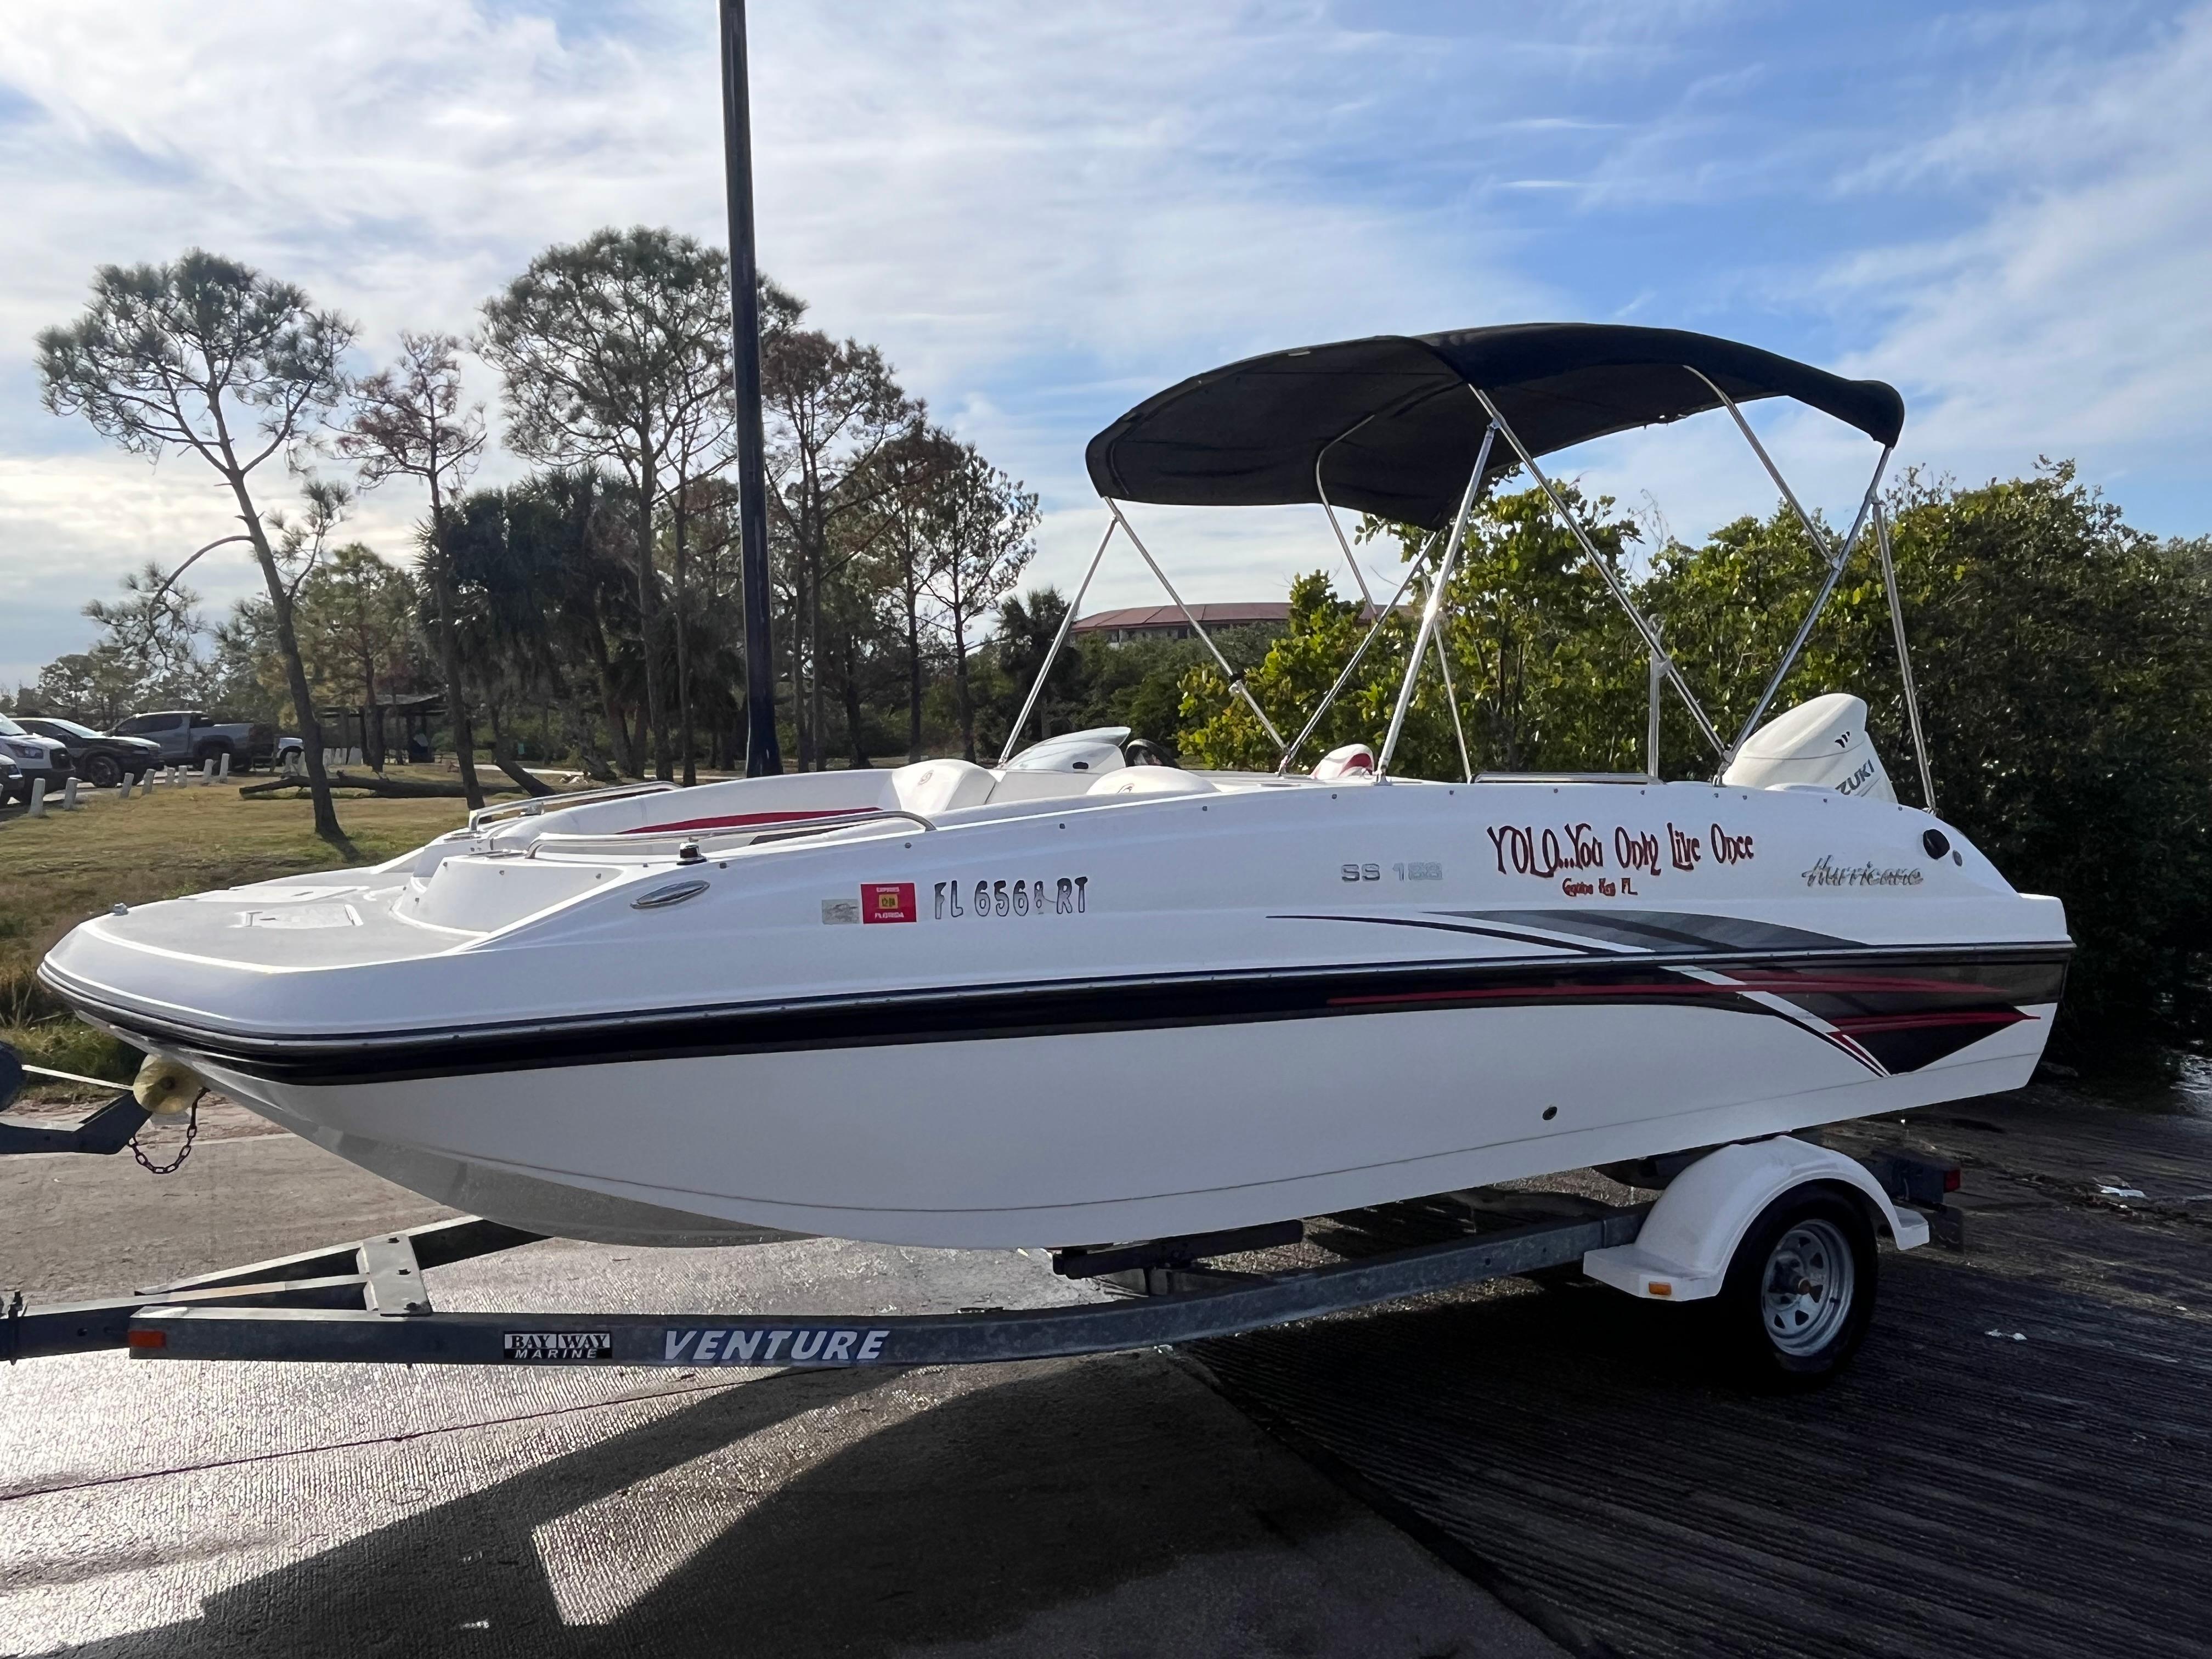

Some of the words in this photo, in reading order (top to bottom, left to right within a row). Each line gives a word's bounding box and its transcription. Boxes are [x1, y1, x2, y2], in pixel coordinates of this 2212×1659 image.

[1835, 759, 1875, 795] ZUKI
[1615, 826, 1662, 876] Only
[1667, 822, 1701, 871] Live
[1711, 823, 1754, 865] Once
[1341, 863, 1380, 882] SS
[1801, 854, 1924, 887] Hurricane
[934, 880, 964, 919] FL
[1057, 877, 1088, 914] RT
[511, 1334, 550, 1348] BAY
[561, 1334, 607, 1348] WAY
[515, 1348, 597, 1359] MARINE
[664, 1330, 890, 1361] VENTURE
